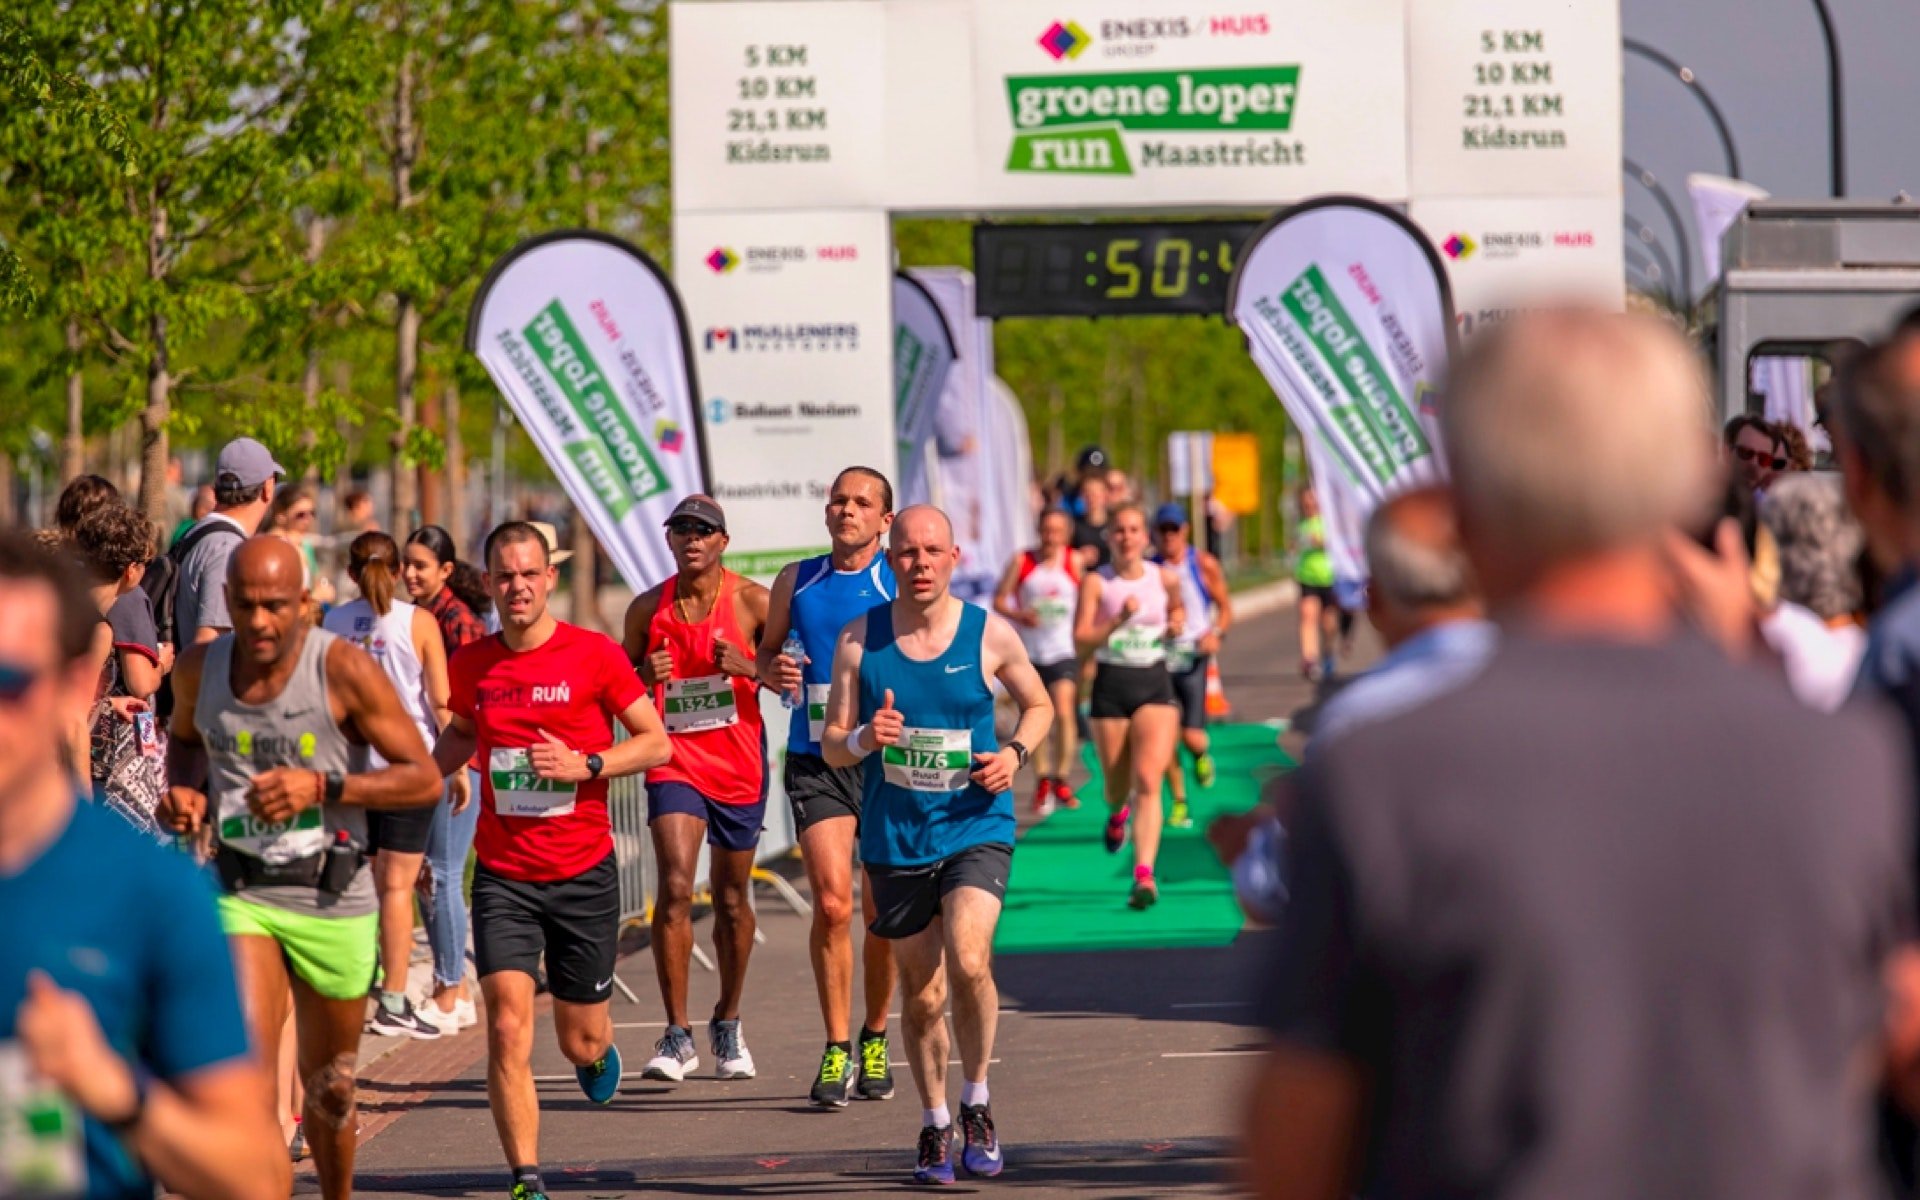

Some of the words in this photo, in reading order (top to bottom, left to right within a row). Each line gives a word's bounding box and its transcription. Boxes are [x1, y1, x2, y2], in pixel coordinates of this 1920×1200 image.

[1101, 17, 1189, 40] ENEXIS
[1209, 14, 1270, 37] HUIS
[1481, 29, 1496, 53] 5
[1503, 29, 1543, 53] KM
[745, 44, 760, 68] 5
[767, 44, 808, 68] KM
[1474, 61, 1504, 85] 10
[1511, 61, 1552, 84] KM
[738, 75, 769, 100] 10
[775, 75, 816, 100] KM
[1018, 82, 1170, 127] groene
[1177, 74, 1294, 124] loper
[1463, 93, 1514, 119] 21,1
[1522, 93, 1563, 117] KM
[727, 107, 778, 134] 21,1
[786, 107, 827, 131] KM
[1463, 124, 1567, 150] Kidsrun
[726, 138, 831, 164] Kidsrun
[1030, 136, 1114, 169] run
[1141, 136, 1306, 168] Maastricht
[531, 686, 571, 703] RUN
[677, 695, 720, 713] 1324
[904, 749, 948, 769] 1176
[912, 770, 941, 780] Ruud
